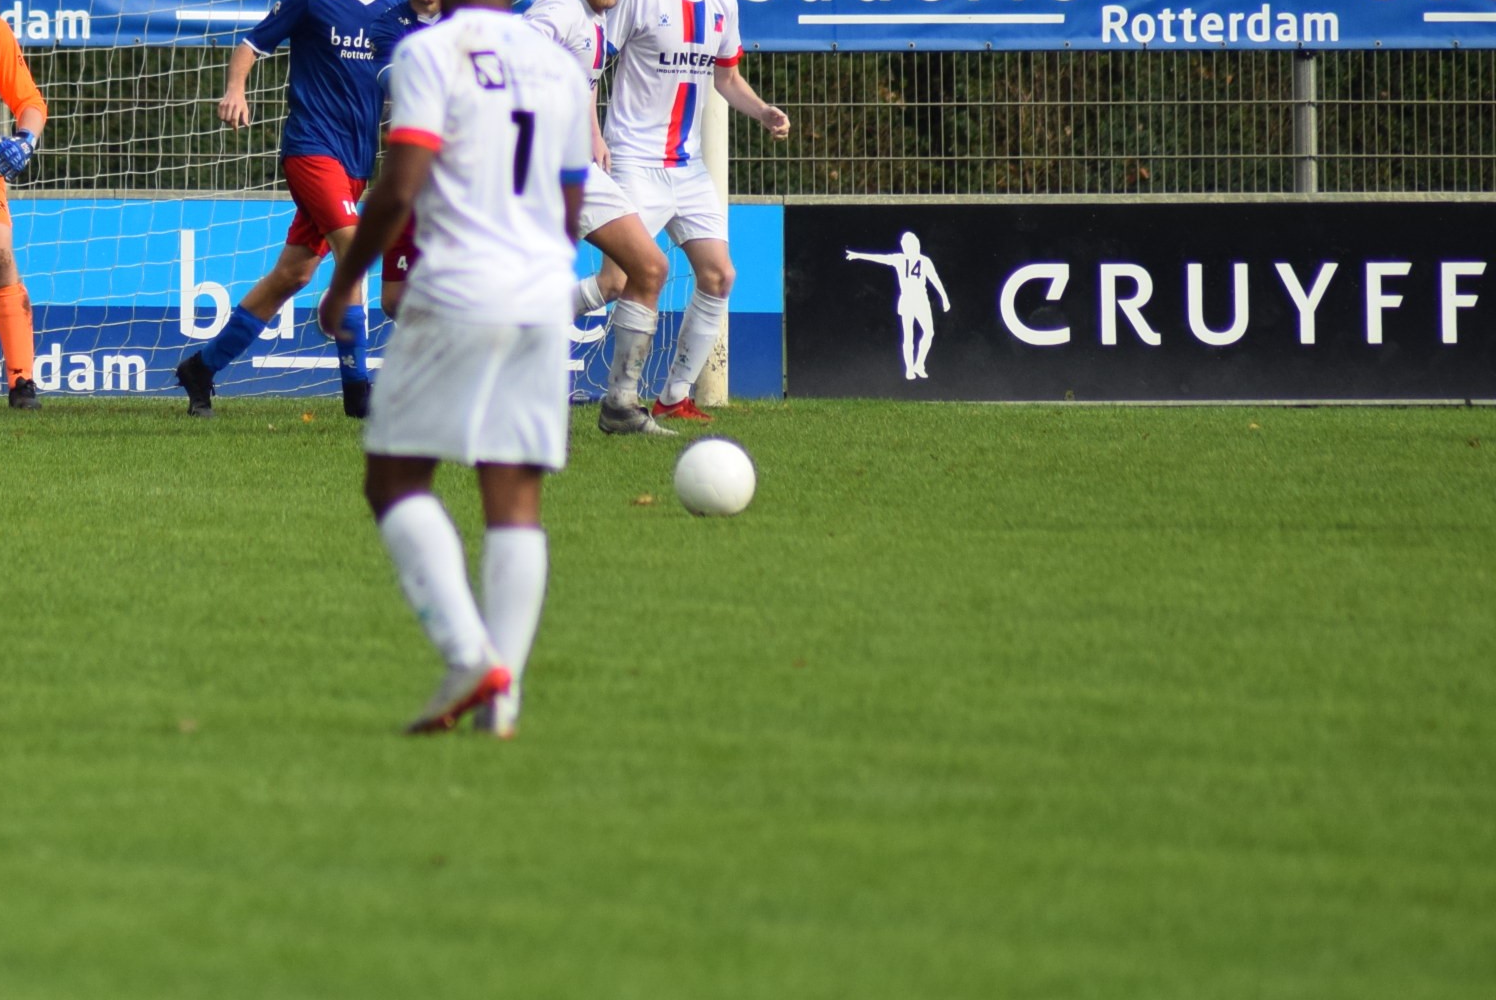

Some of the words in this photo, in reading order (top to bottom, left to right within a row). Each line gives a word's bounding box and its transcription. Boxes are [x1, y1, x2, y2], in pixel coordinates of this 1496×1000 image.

[1102, 3, 1339, 43] Rotterdam
[396, 255, 408, 271] 4
[905, 258, 921, 279] 14
[1000, 262, 1488, 346] CRUYFF
